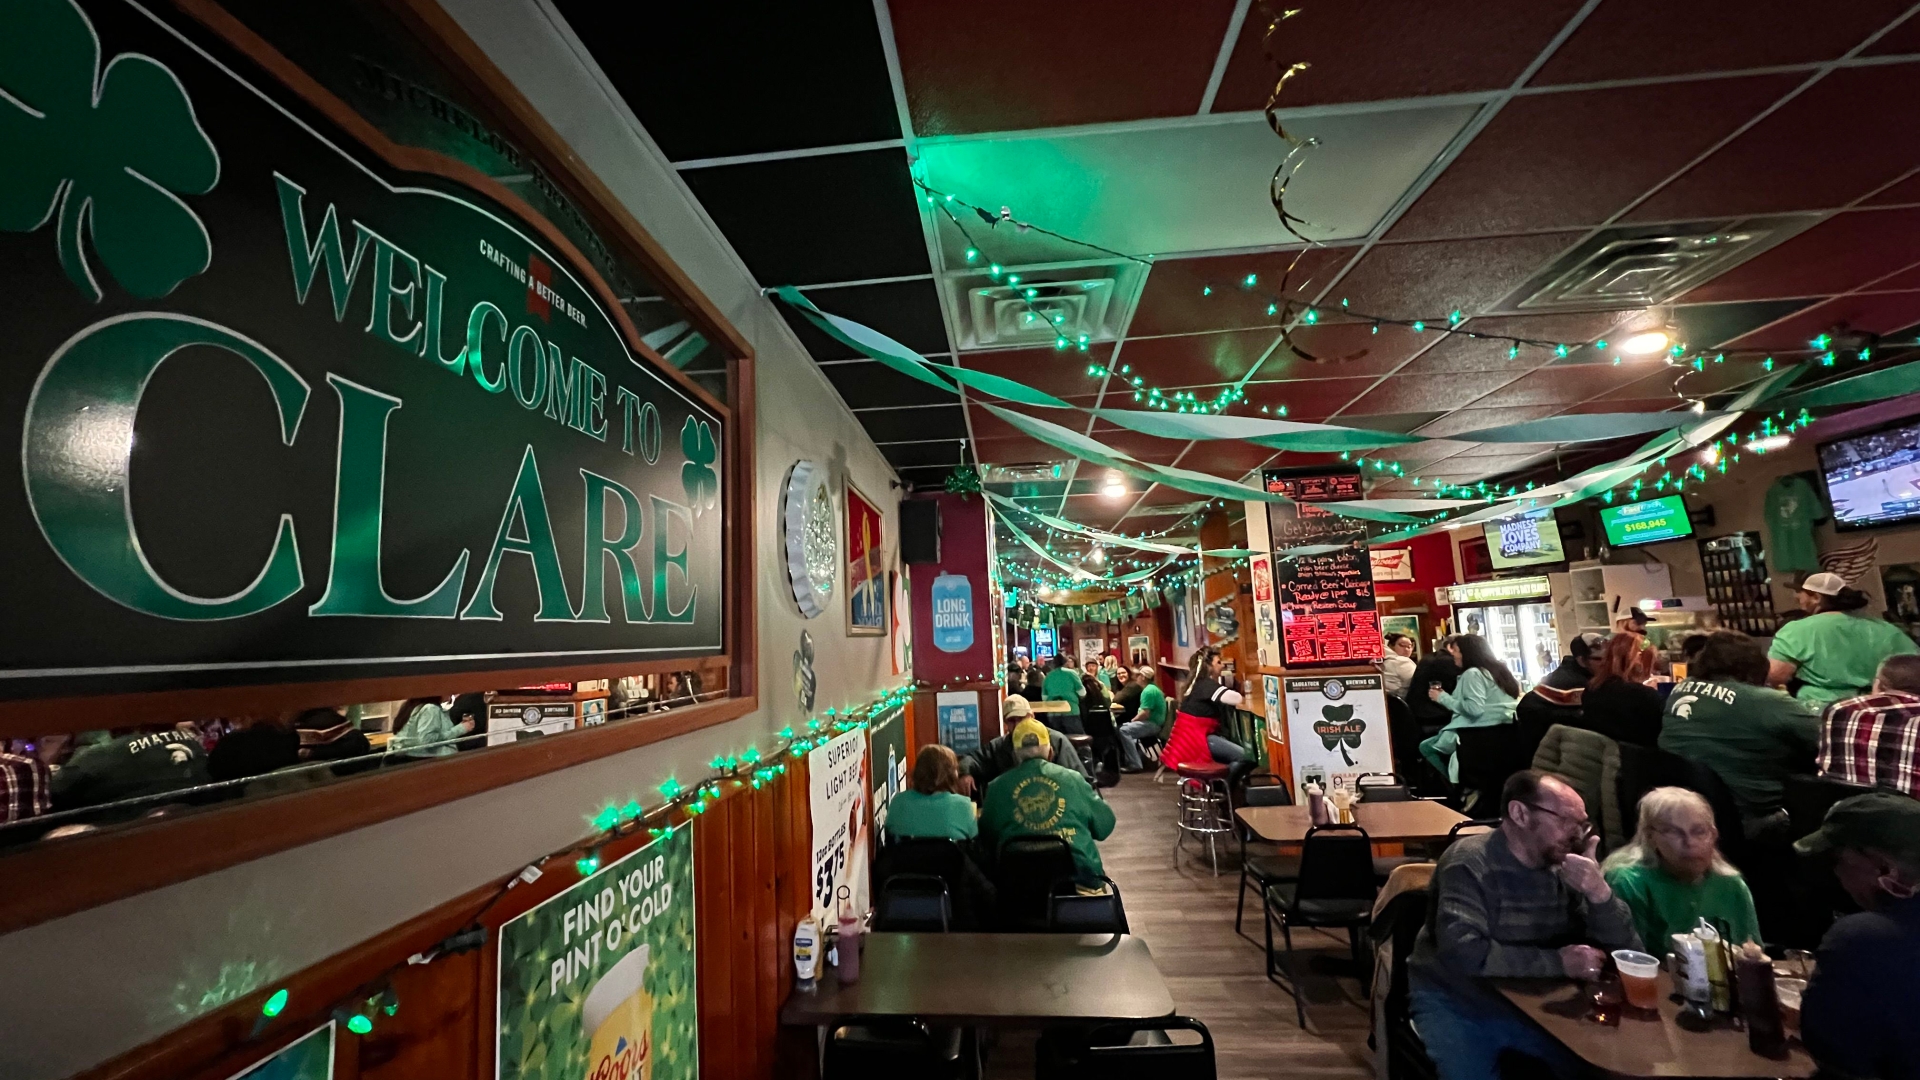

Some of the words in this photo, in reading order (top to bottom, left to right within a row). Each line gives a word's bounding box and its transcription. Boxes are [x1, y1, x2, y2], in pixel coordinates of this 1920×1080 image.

[480, 239, 525, 283] CRAFTING
[528, 276, 535, 289] A
[536, 283, 565, 315] BETTER
[273, 170, 608, 441] WELCOME
[617, 385, 661, 465] TO
[22, 312, 697, 624] CLARE
[1284, 519, 1302, 535] Get
[1500, 519, 1537, 533] MADNESS
[1624, 518, 1667, 532] $168,945
[1502, 528, 1540, 545] LOVES
[1505, 540, 1541, 552] COMPANY
[1288, 580, 1318, 592] Corned
[937, 598, 966, 613] LONG
[935, 612, 970, 628] DRINK
[1671, 681, 1737, 705] ARTANS
[826, 769, 847, 800] LIGHT
[563, 887, 615, 946] FIND
[618, 854, 664, 906] YOUR
[550, 930, 602, 997] PINT
